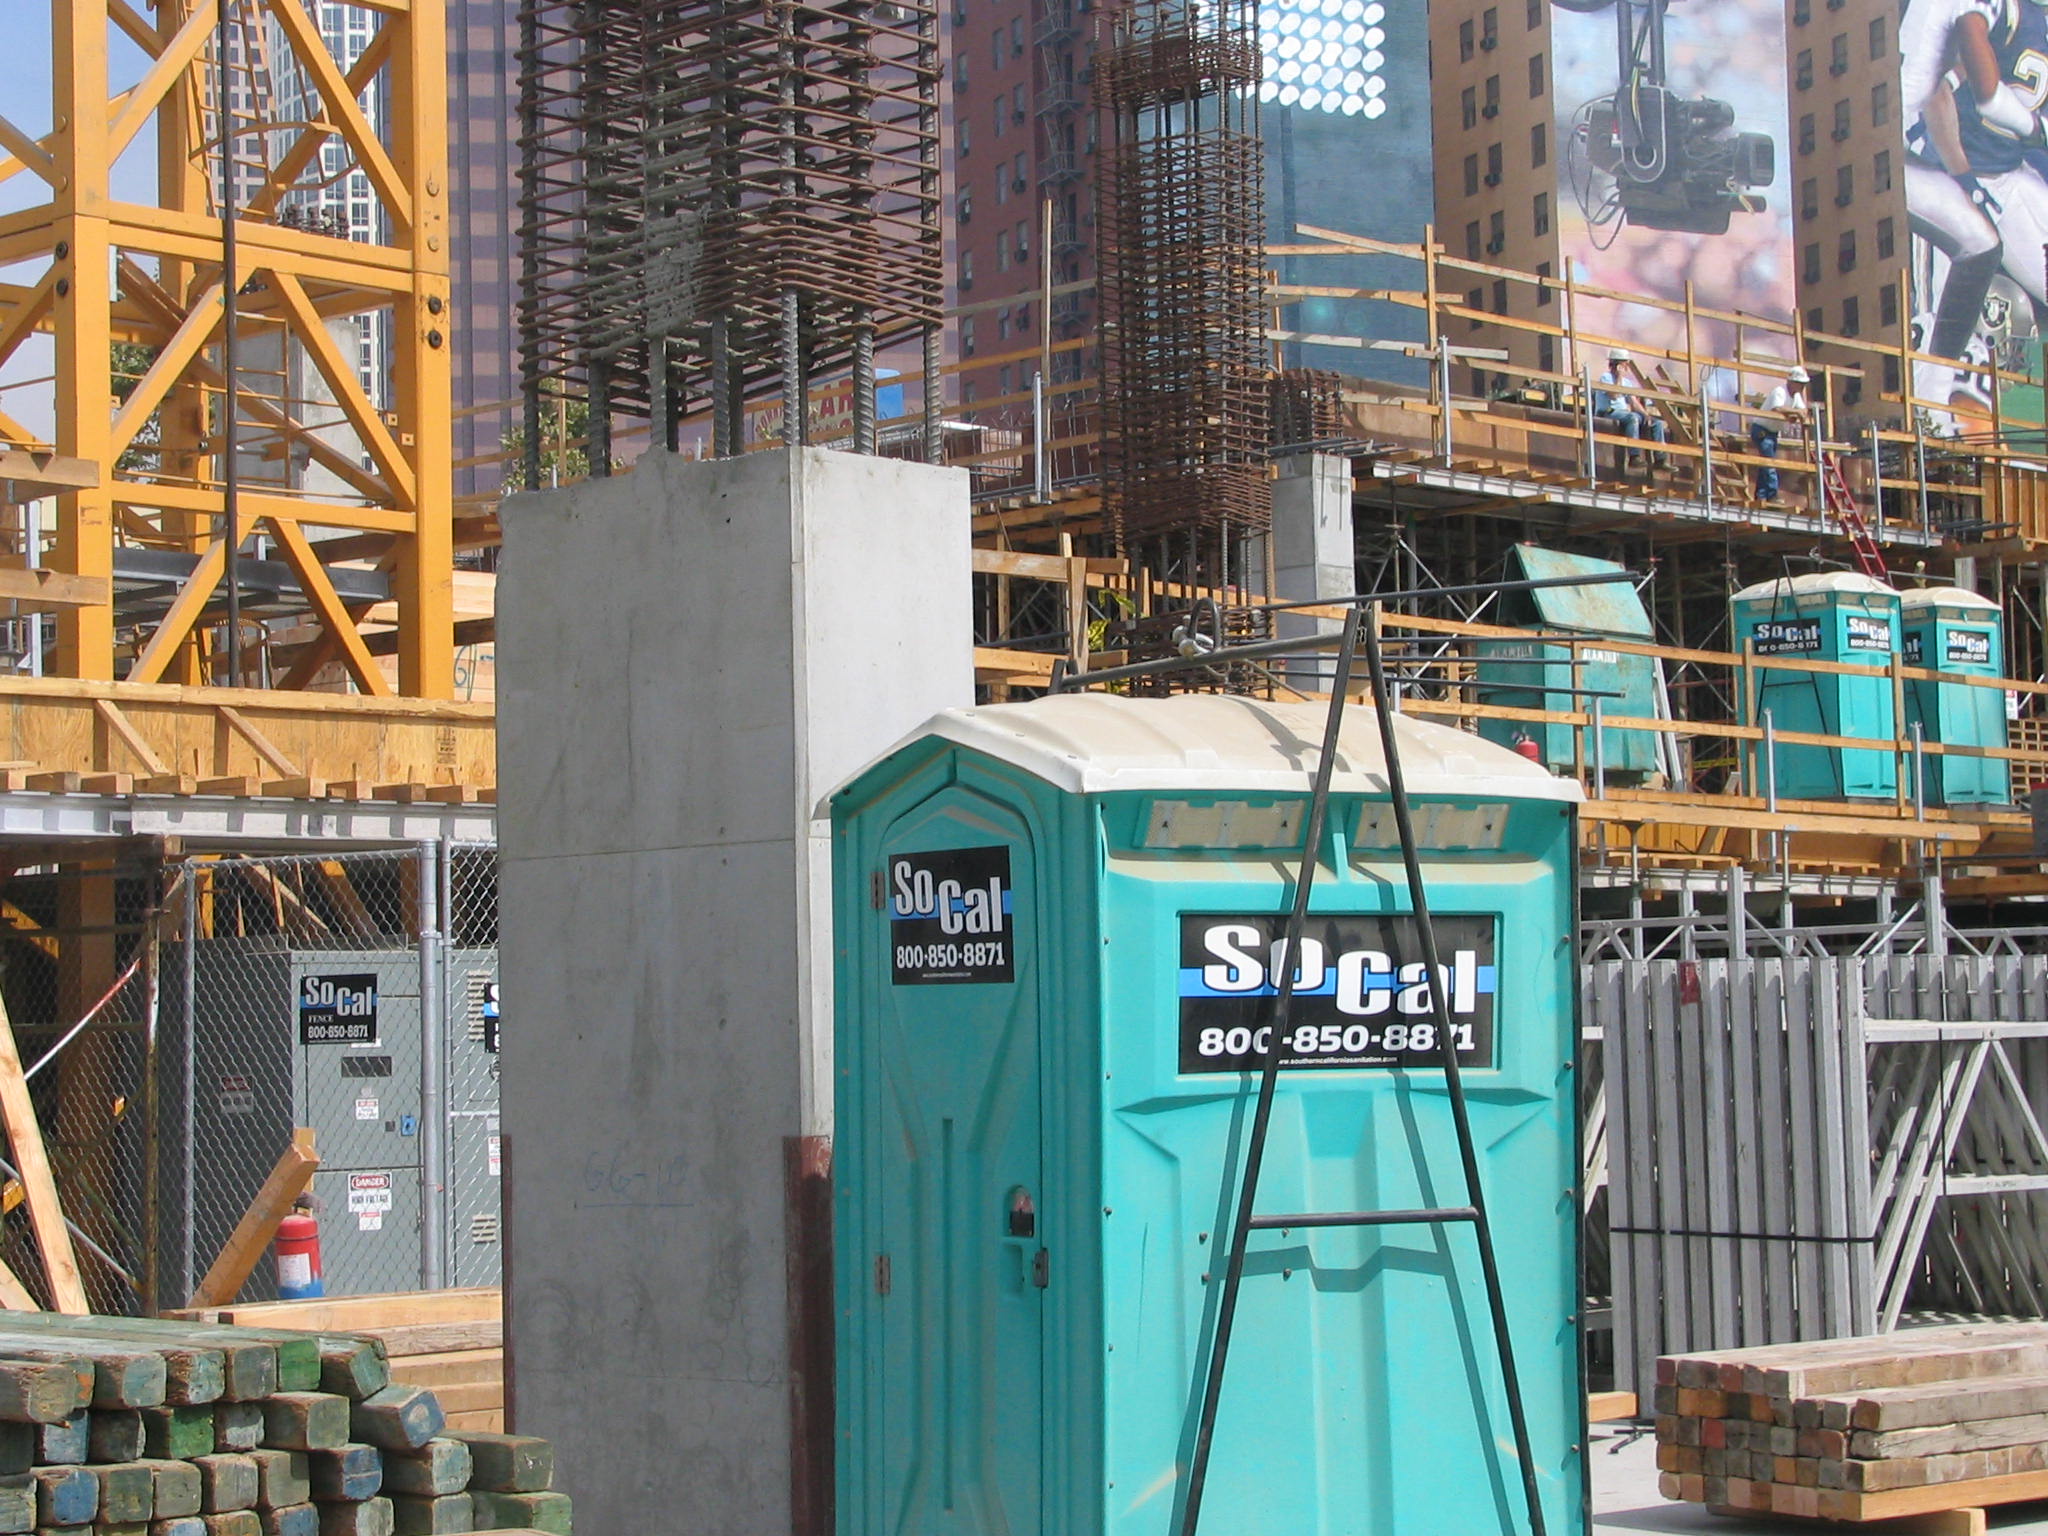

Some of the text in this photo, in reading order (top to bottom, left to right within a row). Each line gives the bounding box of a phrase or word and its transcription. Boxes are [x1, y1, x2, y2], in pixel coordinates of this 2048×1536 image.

[938, 876, 1003, 935] Cal
[896, 941, 1005, 969] 800-850-8871
[336, 986, 373, 1017] Cal
[1336, 949, 1476, 1016] Cal
